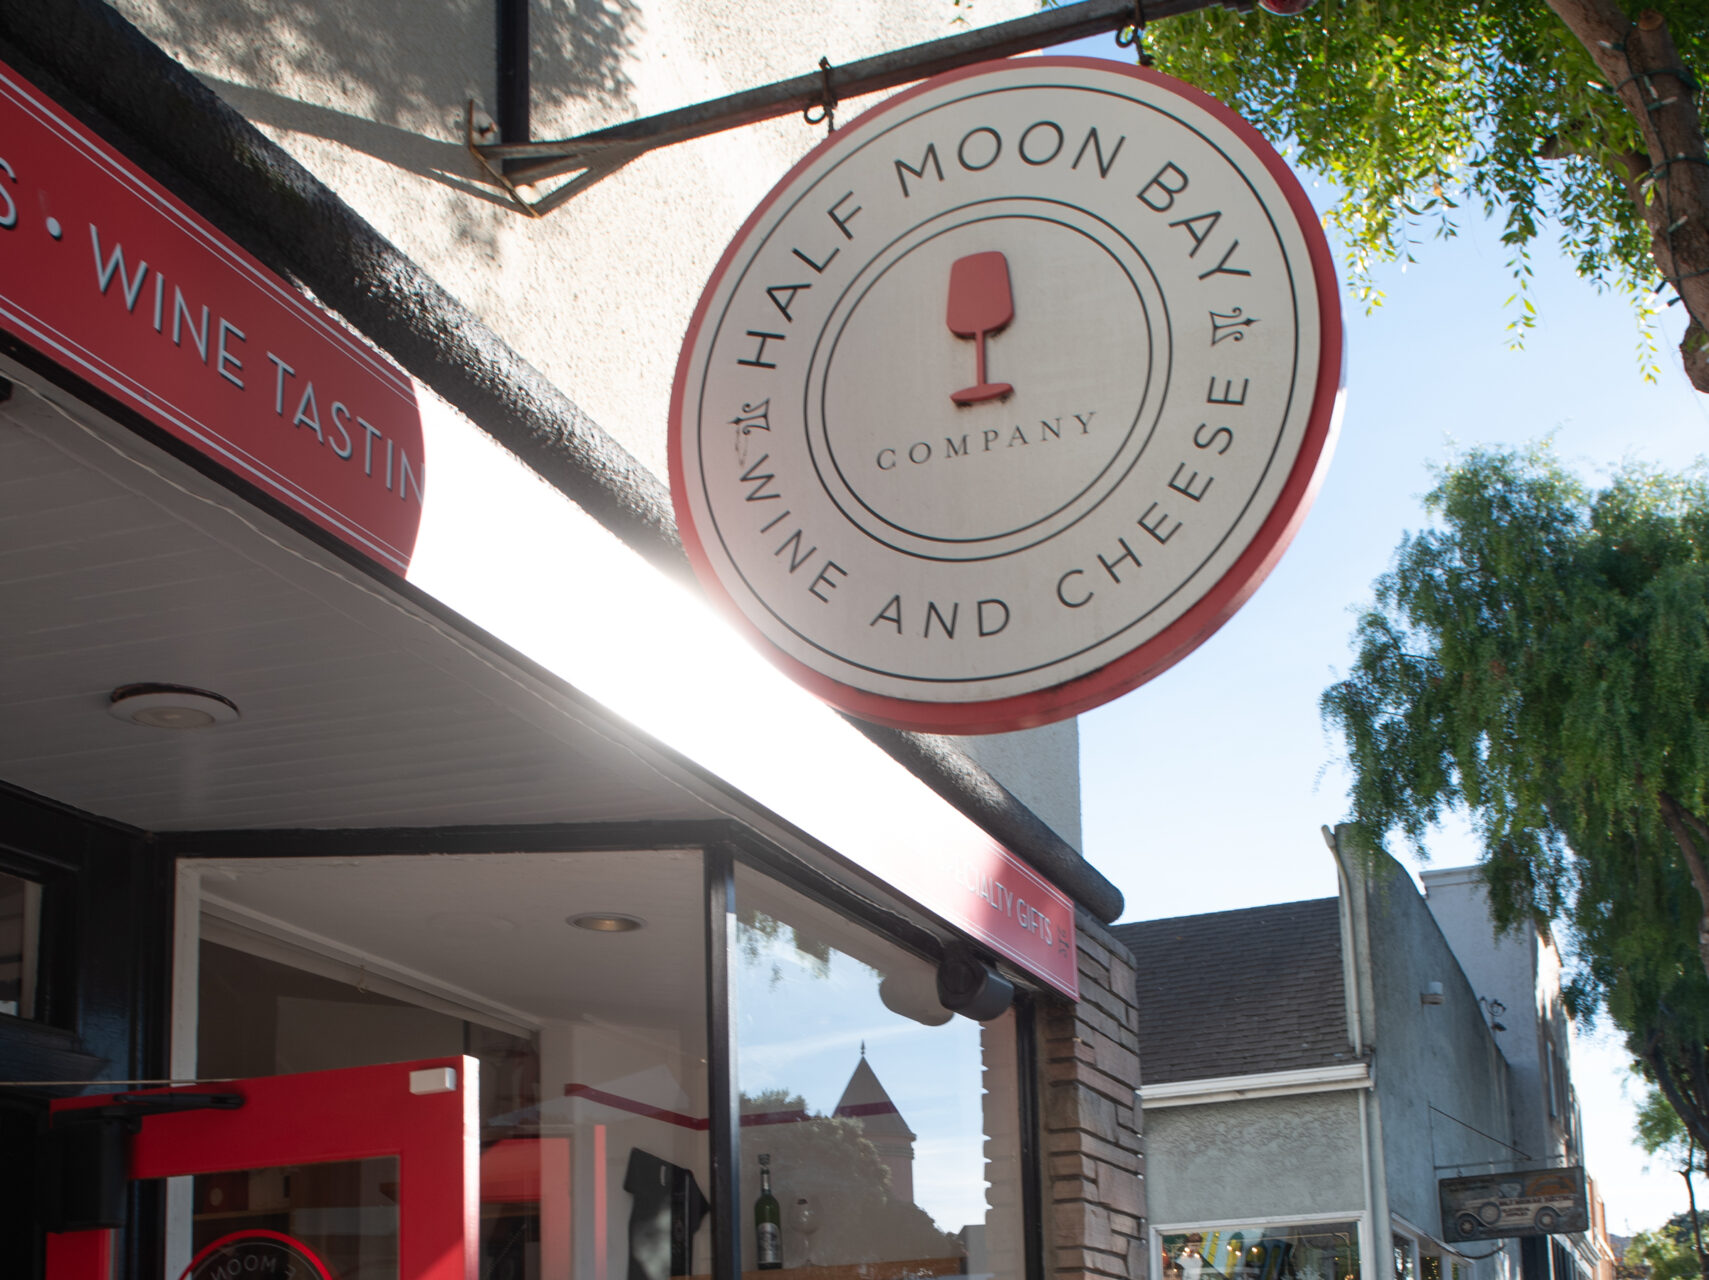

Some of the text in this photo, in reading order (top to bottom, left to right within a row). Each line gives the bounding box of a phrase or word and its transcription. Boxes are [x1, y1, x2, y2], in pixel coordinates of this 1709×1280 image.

[89, 222, 247, 390] WINE
[266, 350, 425, 507] TASTIN
[736, 119, 1253, 370] HALF MOON BAY
[739, 375, 1250, 640] WINE AND CHEESE
[875, 410, 1098, 472] COMPANY
[1015, 897, 1053, 946] GIFTS
